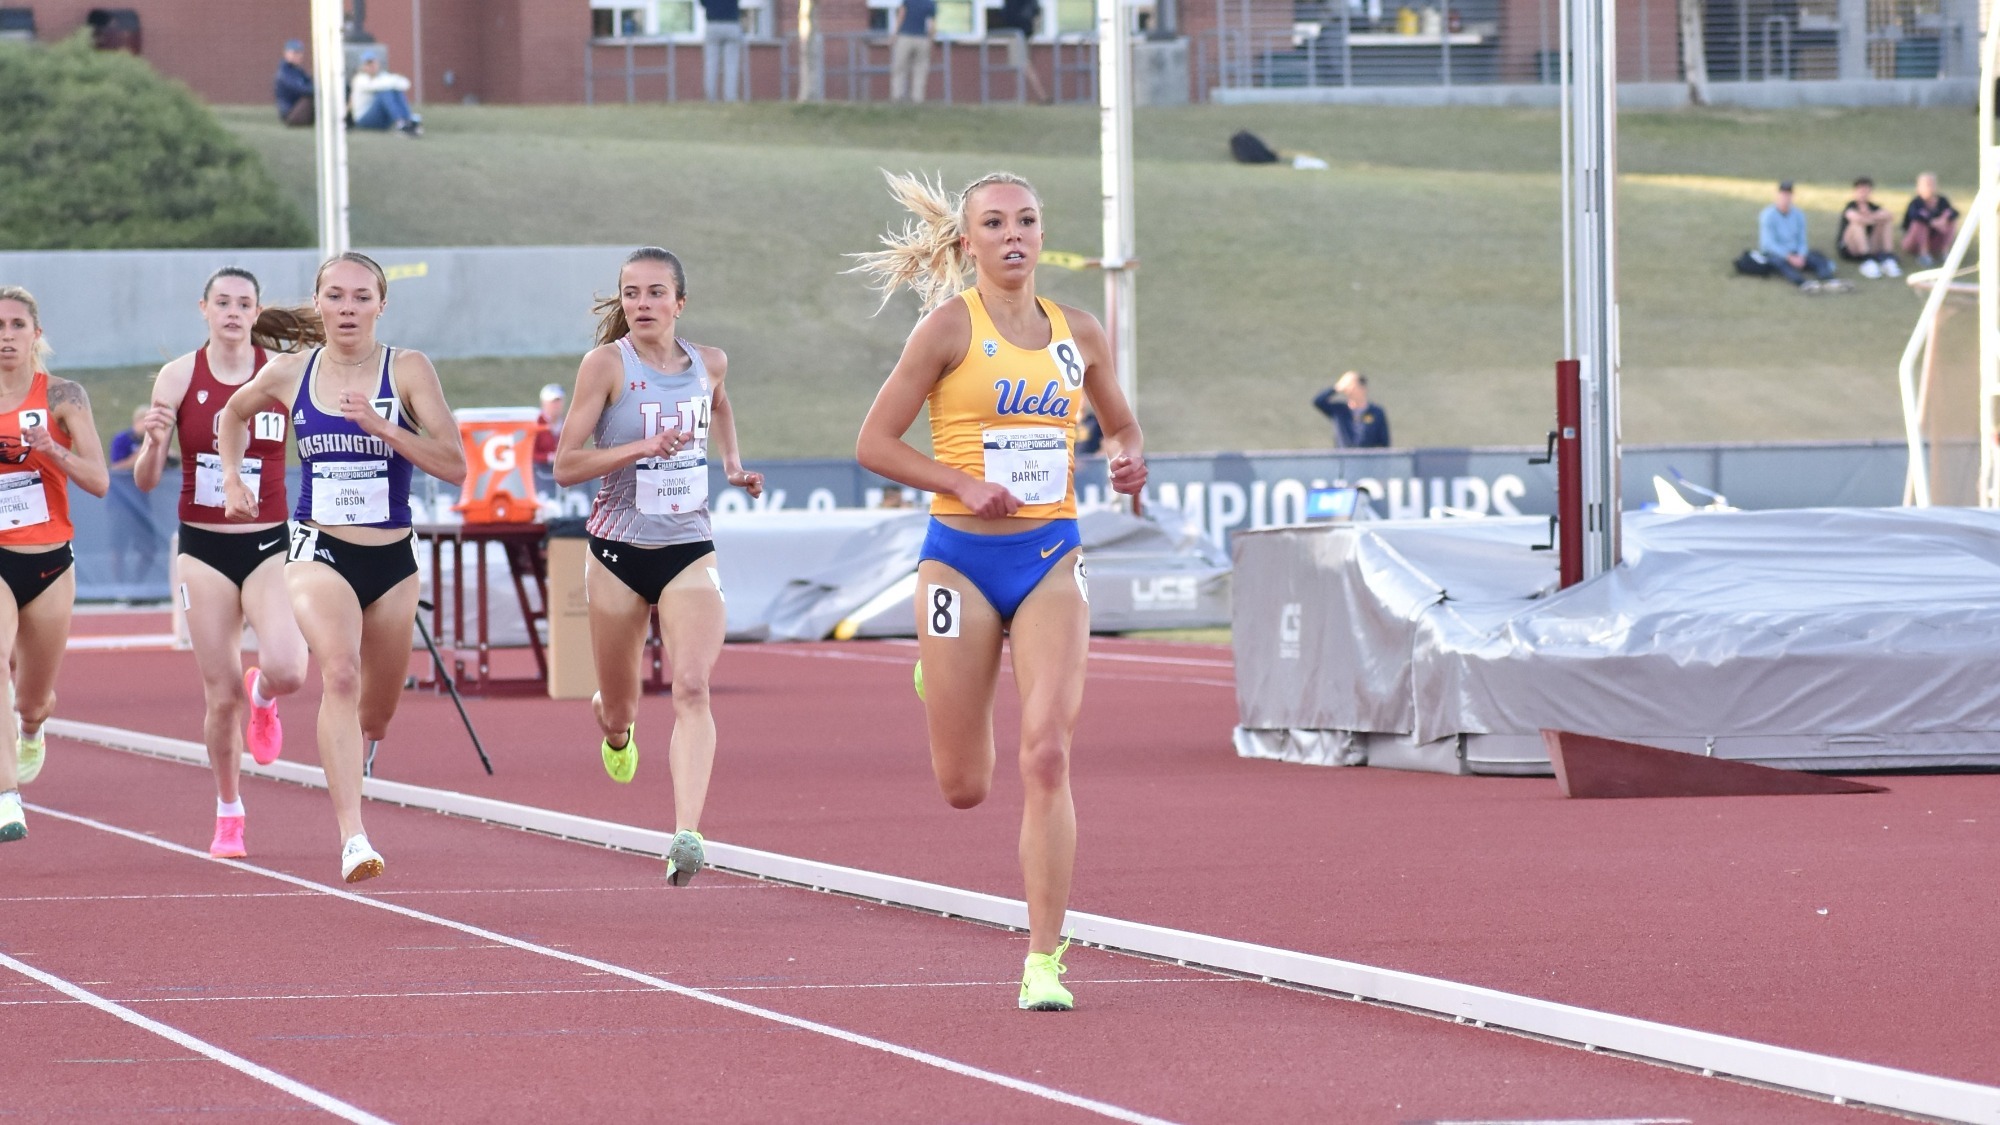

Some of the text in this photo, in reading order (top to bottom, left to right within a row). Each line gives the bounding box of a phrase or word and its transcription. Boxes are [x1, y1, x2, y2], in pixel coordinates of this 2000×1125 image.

[1057, 343, 1082, 387] 8
[994, 378, 1071, 418] Ucla
[374, 401, 393, 421] 7
[698, 398, 708, 428] 4
[262, 414, 280, 438] 11
[297, 433, 394, 459] WASHINGTON
[483, 434, 516, 471] G
[1010, 440, 1059, 449] CHAMPIONSHIPS
[1024, 460, 1039, 470] MIA
[662, 477, 686, 487] SIMONE
[1012, 471, 1050, 482] BARNETT
[335, 496, 365, 506] GIBSON
[340, 488, 360, 496] ANNA
[657, 486, 691, 497] PLOURDE
[345, 513, 356, 522] W
[1131, 577, 1197, 601] UCS
[933, 588, 953, 635] 8
